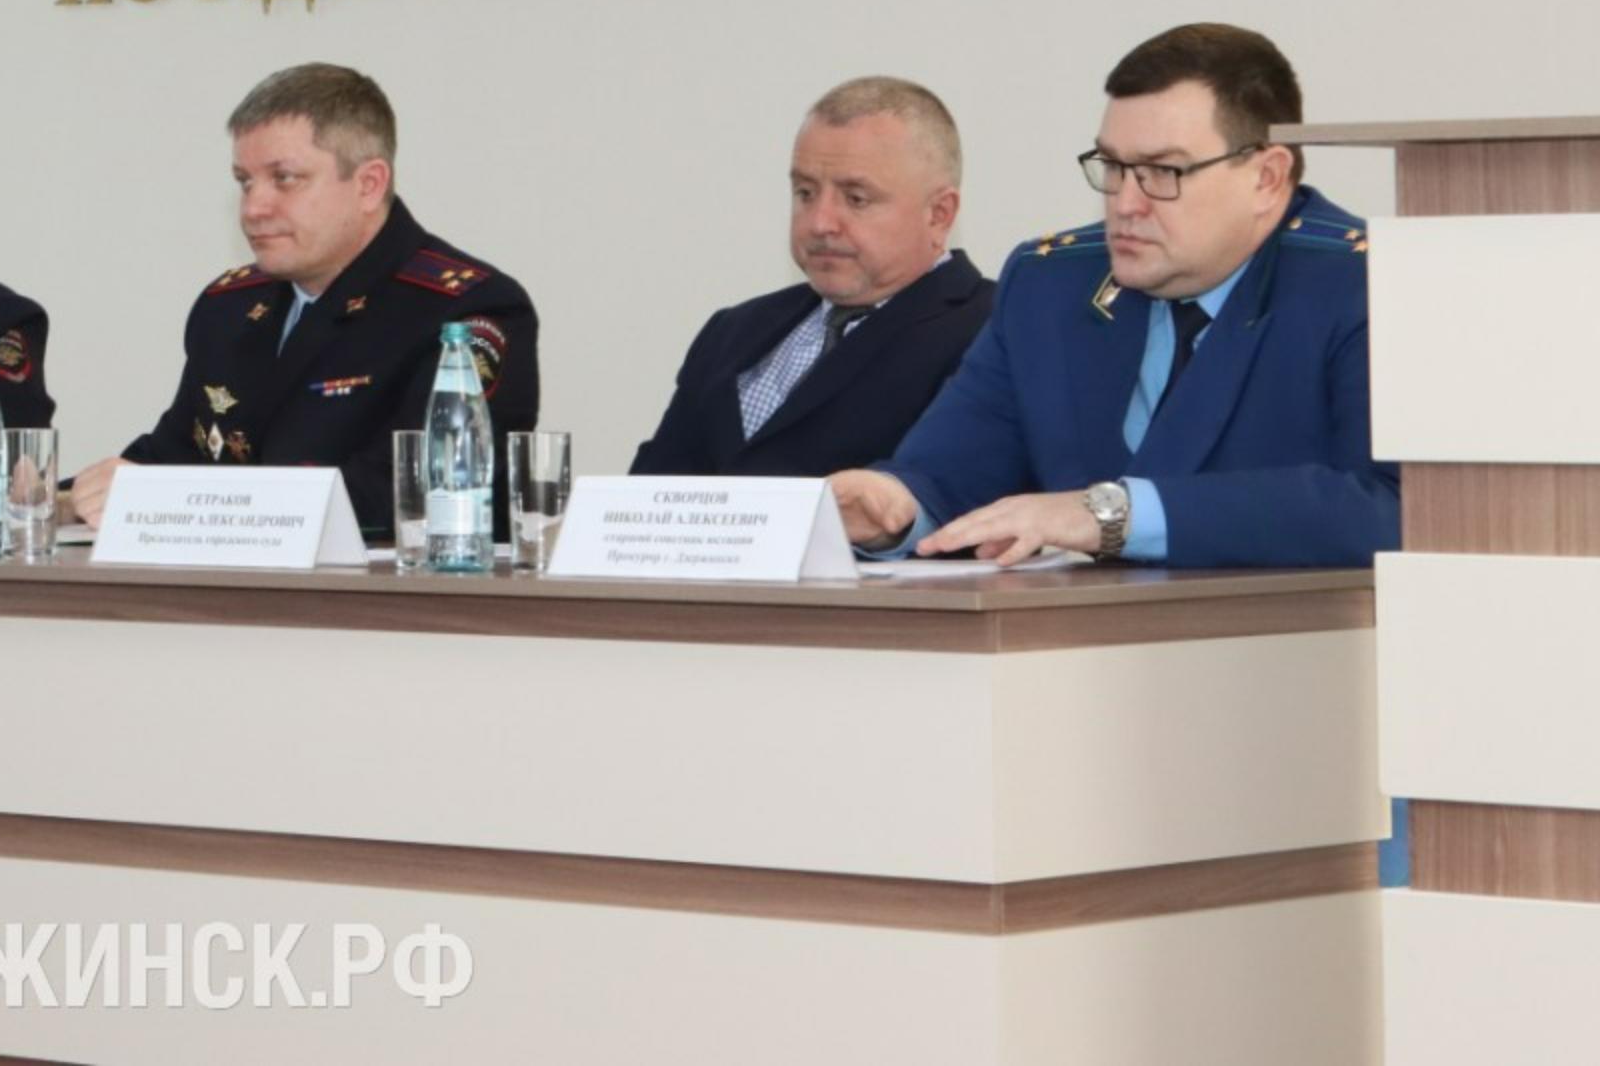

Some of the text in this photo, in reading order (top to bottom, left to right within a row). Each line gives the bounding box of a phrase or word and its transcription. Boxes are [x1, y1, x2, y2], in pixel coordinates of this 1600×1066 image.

[186, 493, 252, 506] СЕТРАКОВ
[653, 491, 729, 505] СКВОРЦОВ
[125, 512, 305, 529] ВЛАДИМИР АЛЕКСАНДРОВИЧ
[603, 509, 769, 526] НИКОЛАЙ АЛЕКСЕЕВИЧ
